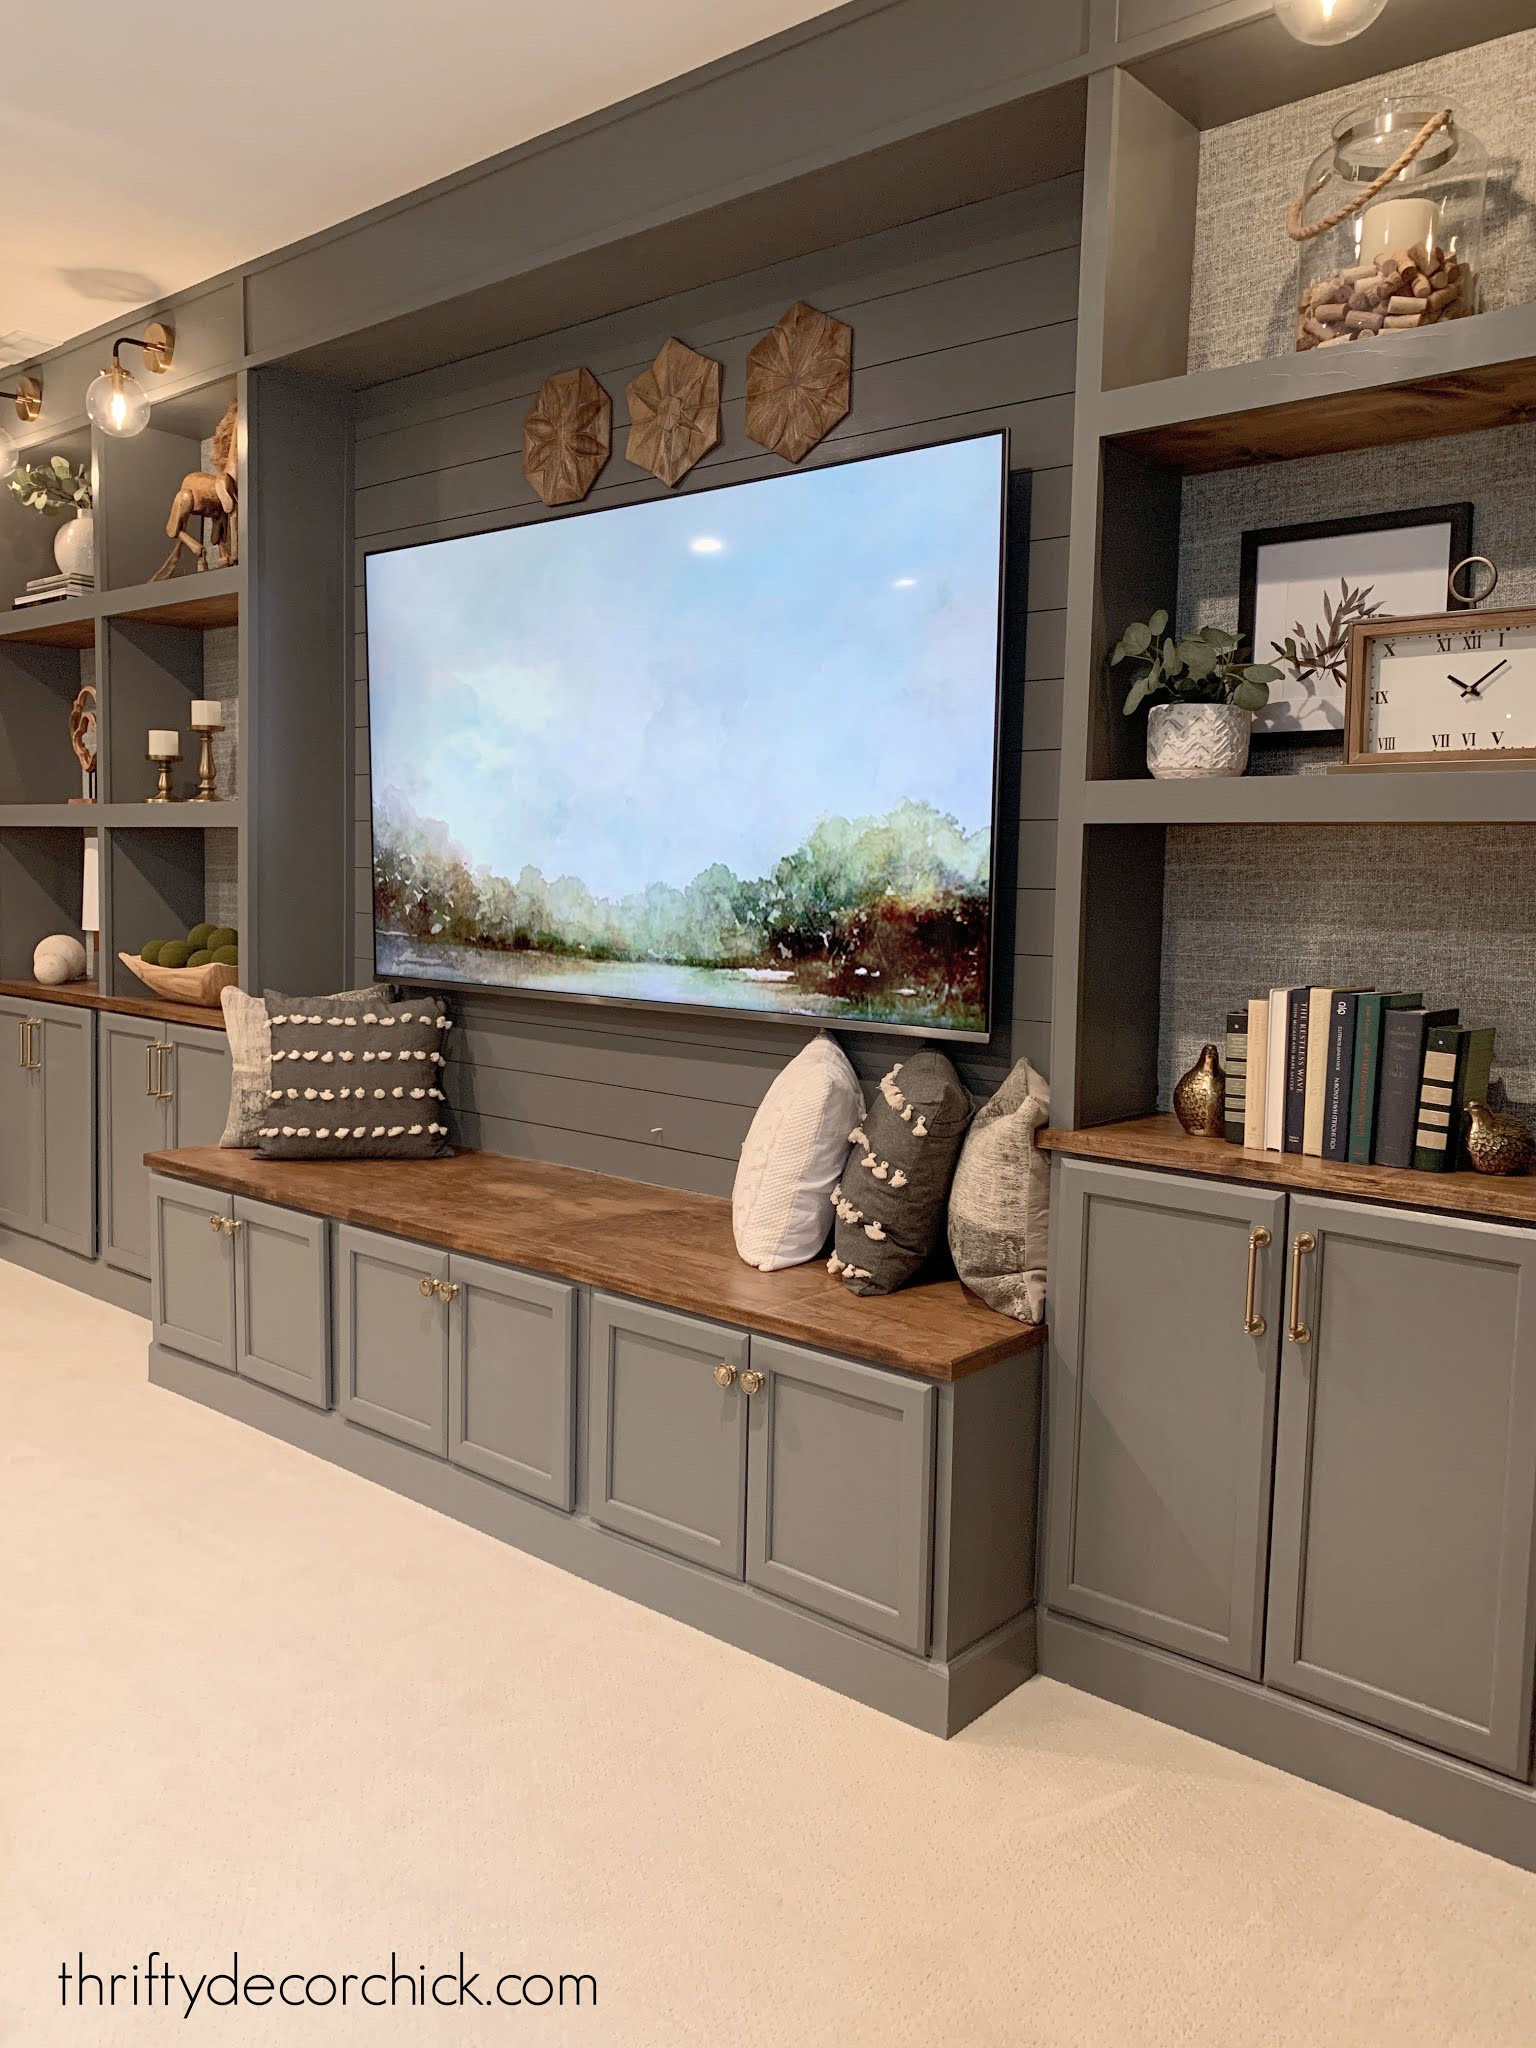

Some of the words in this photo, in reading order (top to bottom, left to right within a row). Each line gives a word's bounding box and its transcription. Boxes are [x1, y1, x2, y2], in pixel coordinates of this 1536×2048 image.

[1437, 637, 1452, 652] XI
[1463, 635, 1482, 650] XII
[1498, 632, 1505, 647] I
[1383, 642, 1396, 657] X
[1375, 691, 1389, 704] IX
[1378, 736, 1395, 751] VIII
[1431, 734, 1451, 748] VII
[1461, 732, 1476, 746] VI
[1491, 731, 1505, 745] V
[1300, 1001, 1308, 1021] THE
[1297, 1023, 1307, 1066] RESTLESS
[1295, 1068, 1305, 1094] WAVE
[1330, 1115, 1338, 1138] SHOULD
